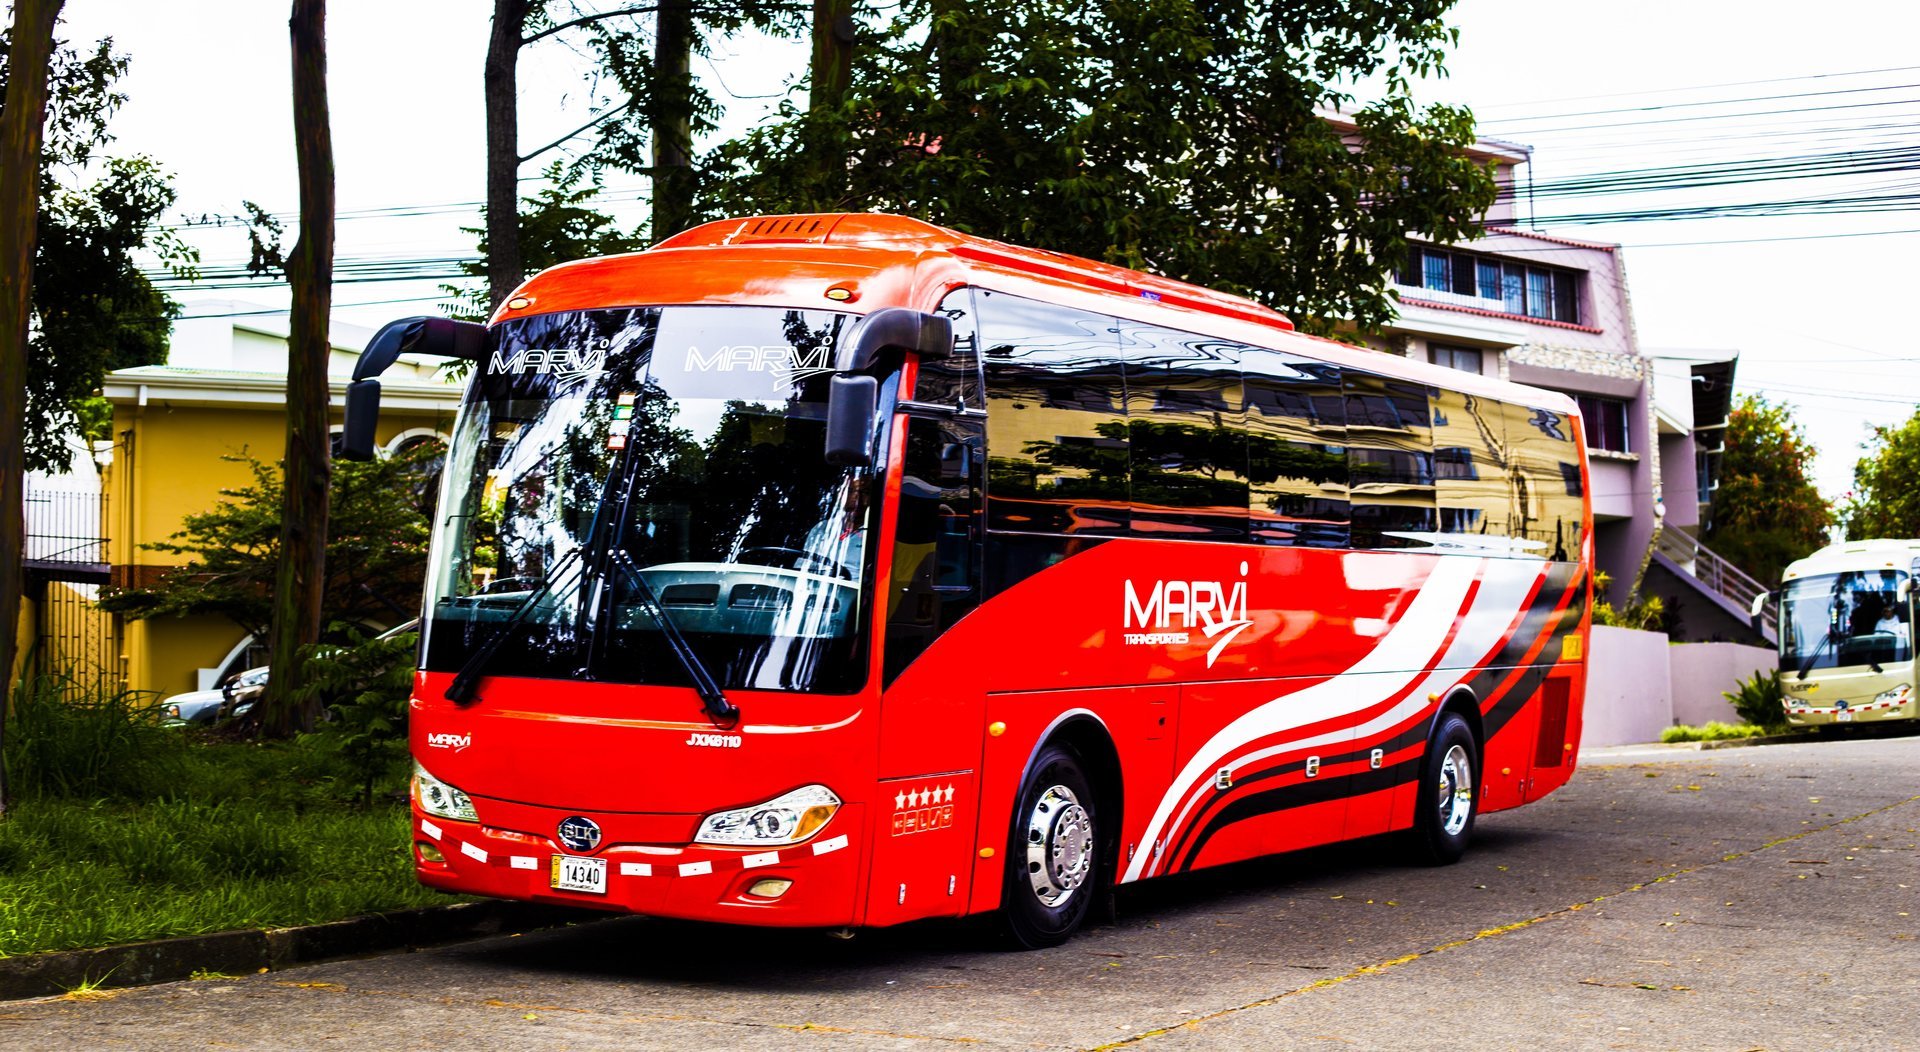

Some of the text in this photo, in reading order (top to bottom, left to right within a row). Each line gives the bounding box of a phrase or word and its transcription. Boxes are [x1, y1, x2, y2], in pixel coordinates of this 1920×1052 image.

[1123, 632, 1189, 645] TRANSPORTES
[685, 733, 742, 748] JXK6110
[565, 865, 600, 885] 14340
